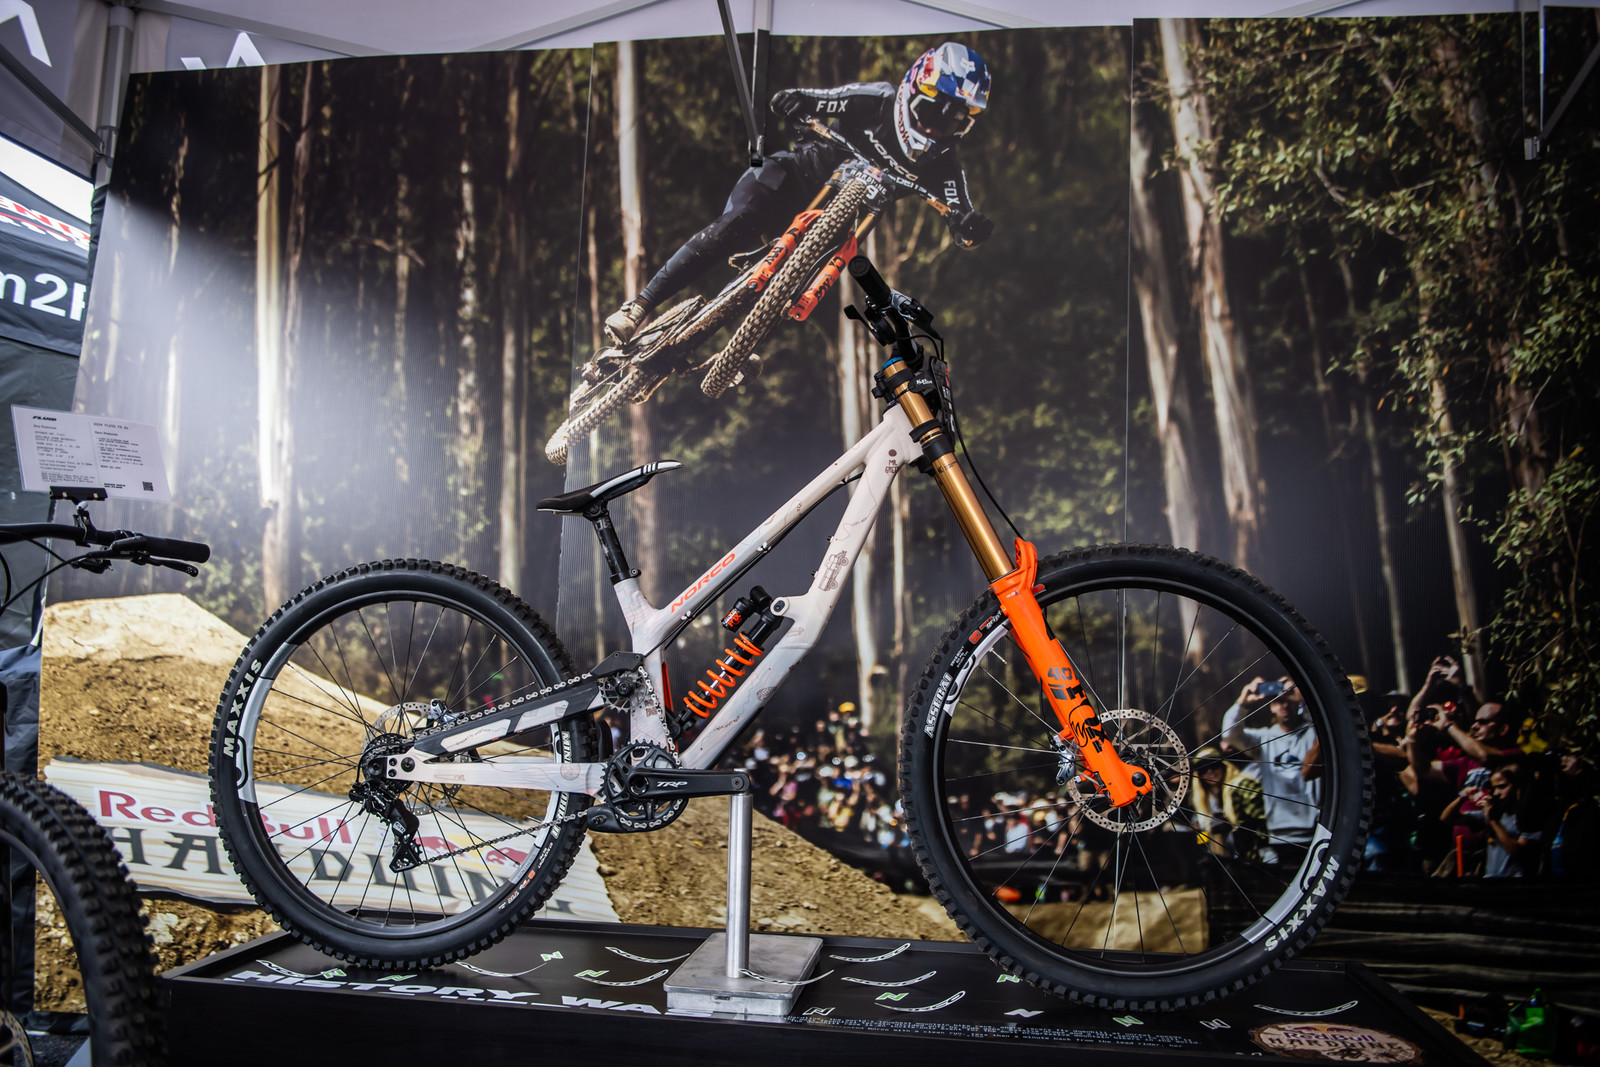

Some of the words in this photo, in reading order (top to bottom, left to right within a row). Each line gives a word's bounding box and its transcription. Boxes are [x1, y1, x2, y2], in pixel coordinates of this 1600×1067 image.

[815, 99, 849, 113] FOX
[863, 129, 919, 182] NORCO
[944, 180, 961, 206] FOX
[670, 552, 736, 615] NORCO
[1047, 666, 1074, 681] 40
[222, 658, 263, 758] MAXXIS
[98, 789, 220, 829] Red
[1264, 855, 1341, 952] MAXXIS
[1282, 1031, 1329, 1042] Red
[1332, 1033, 1376, 1043] Bull
